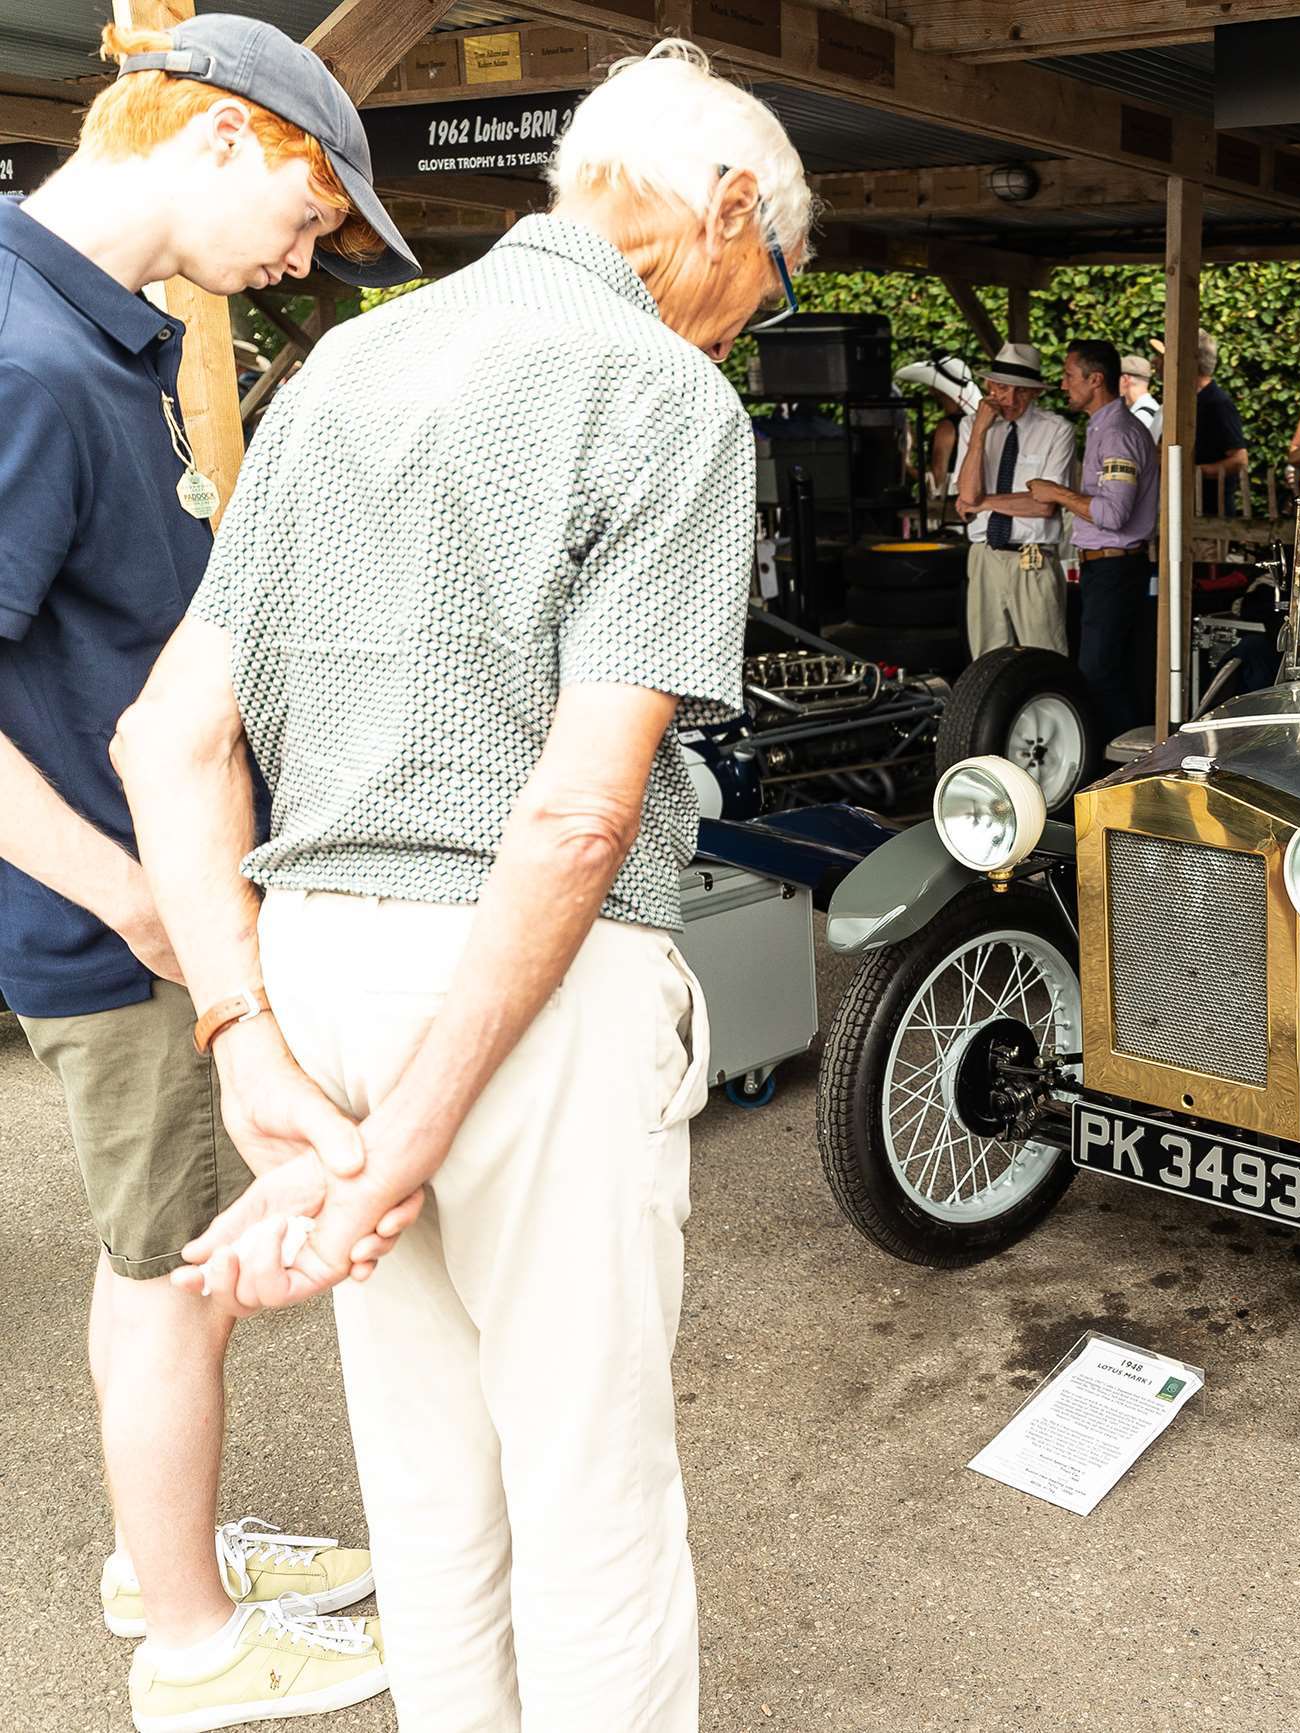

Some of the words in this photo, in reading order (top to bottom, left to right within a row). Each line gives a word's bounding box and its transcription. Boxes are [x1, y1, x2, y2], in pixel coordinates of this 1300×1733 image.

[428, 119, 470, 145] 1962
[474, 109, 558, 142] Lotus-BRM
[418, 158, 456, 172] GLOVER
[458, 155, 495, 169] TROPHY
[497, 155, 505, 167] &
[506, 154, 517, 166] 75
[518, 152, 548, 165] YEARS
[1080, 1111, 1145, 1177] PK
[1097, 1363, 1122, 1375] LOTUS
[1124, 1372, 1148, 1384] MARK
[1120, 1359, 1144, 1372] 1948
